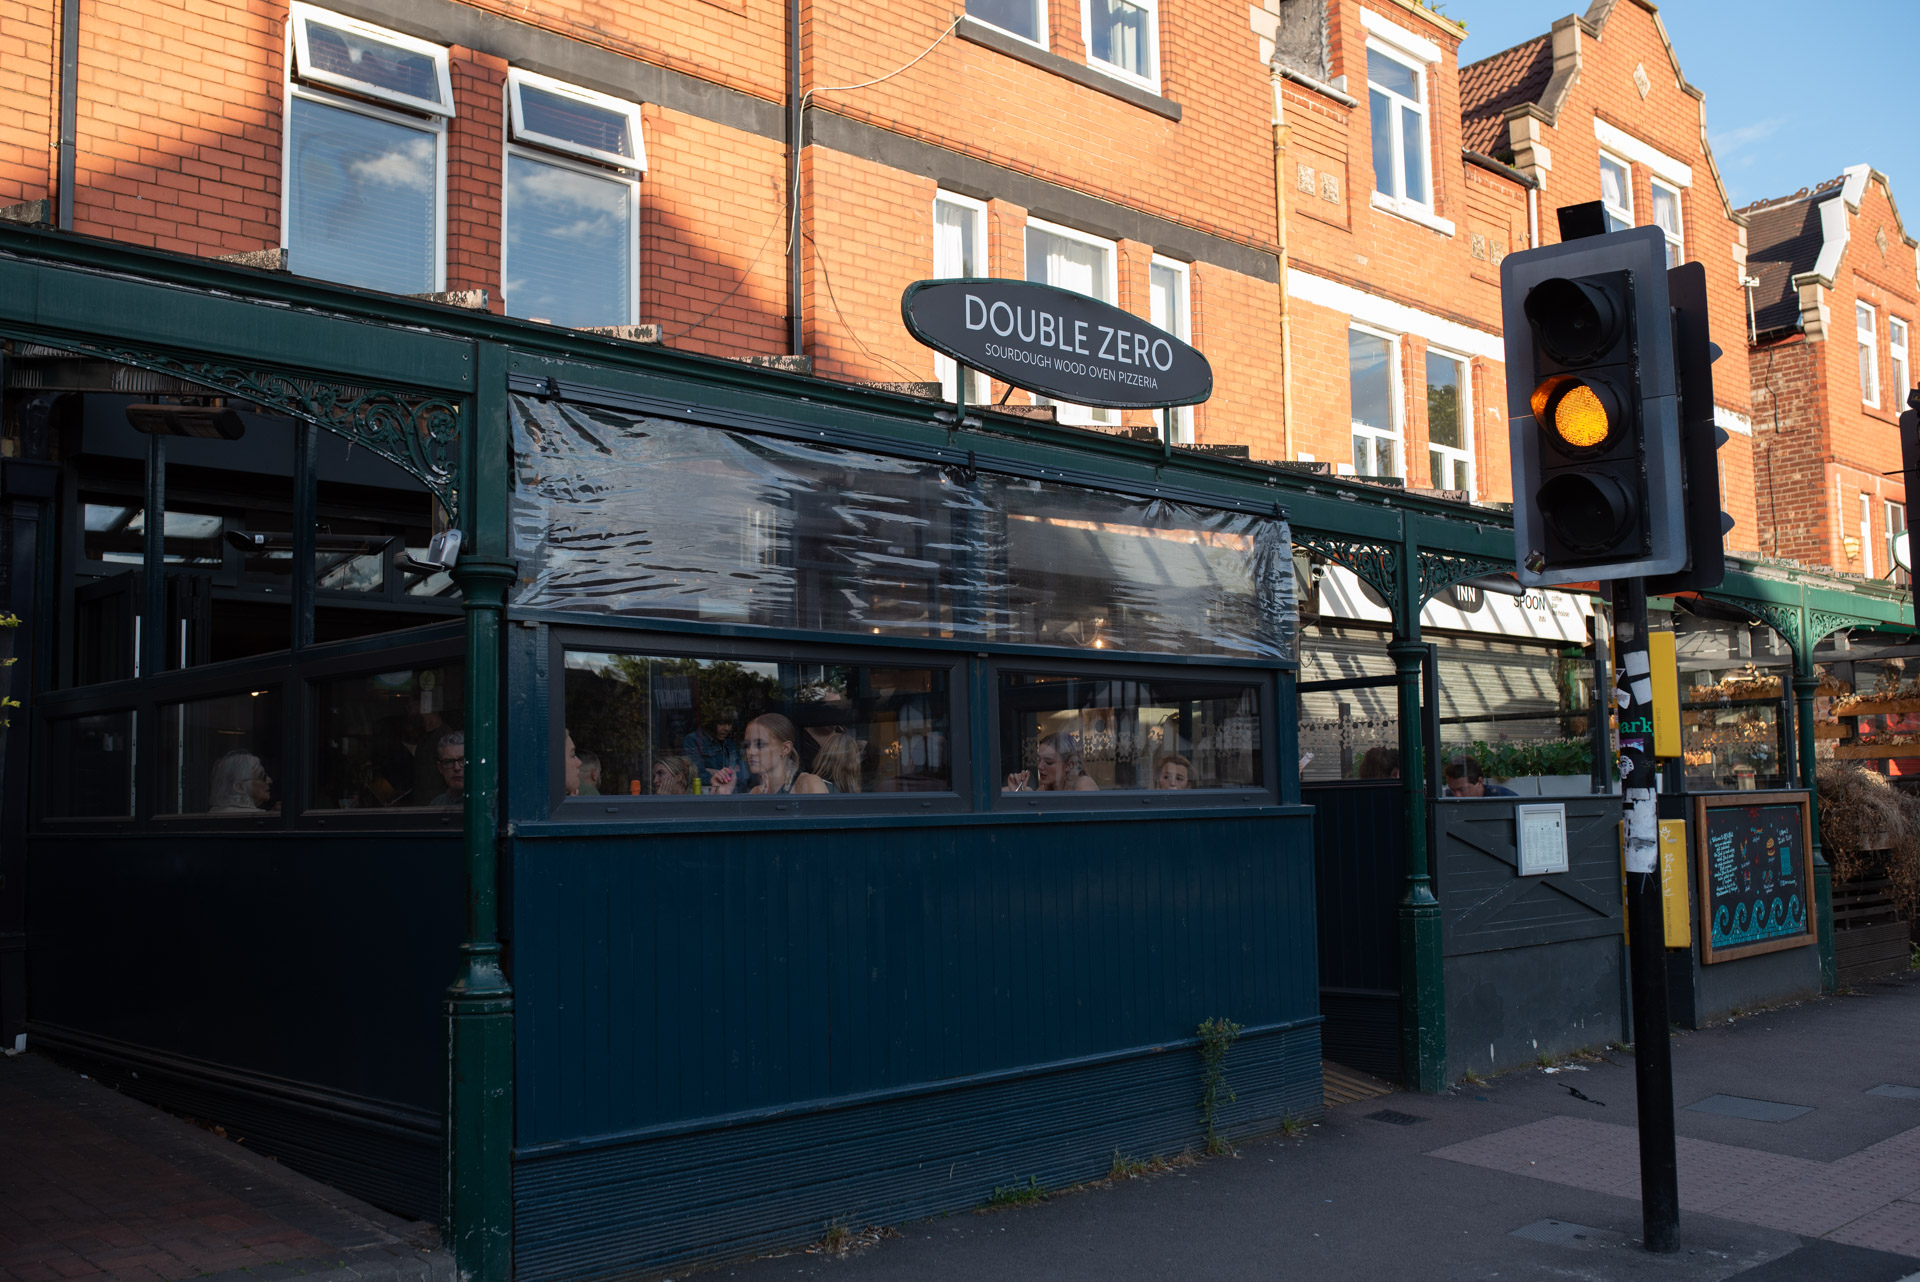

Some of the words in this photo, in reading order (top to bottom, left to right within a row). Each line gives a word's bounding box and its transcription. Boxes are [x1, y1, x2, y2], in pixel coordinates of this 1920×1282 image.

[965, 294, 1090, 356] DOUBLE
[1097, 325, 1173, 372] ZERO
[985, 342, 1052, 369] SOURDOUGH
[1053, 358, 1087, 376] WOOD
[1088, 365, 1116, 382] OVEN
[1118, 371, 1158, 390] PIZZERIA
[1456, 584, 1476, 603] INN
[1513, 595, 1546, 611] SPOON
